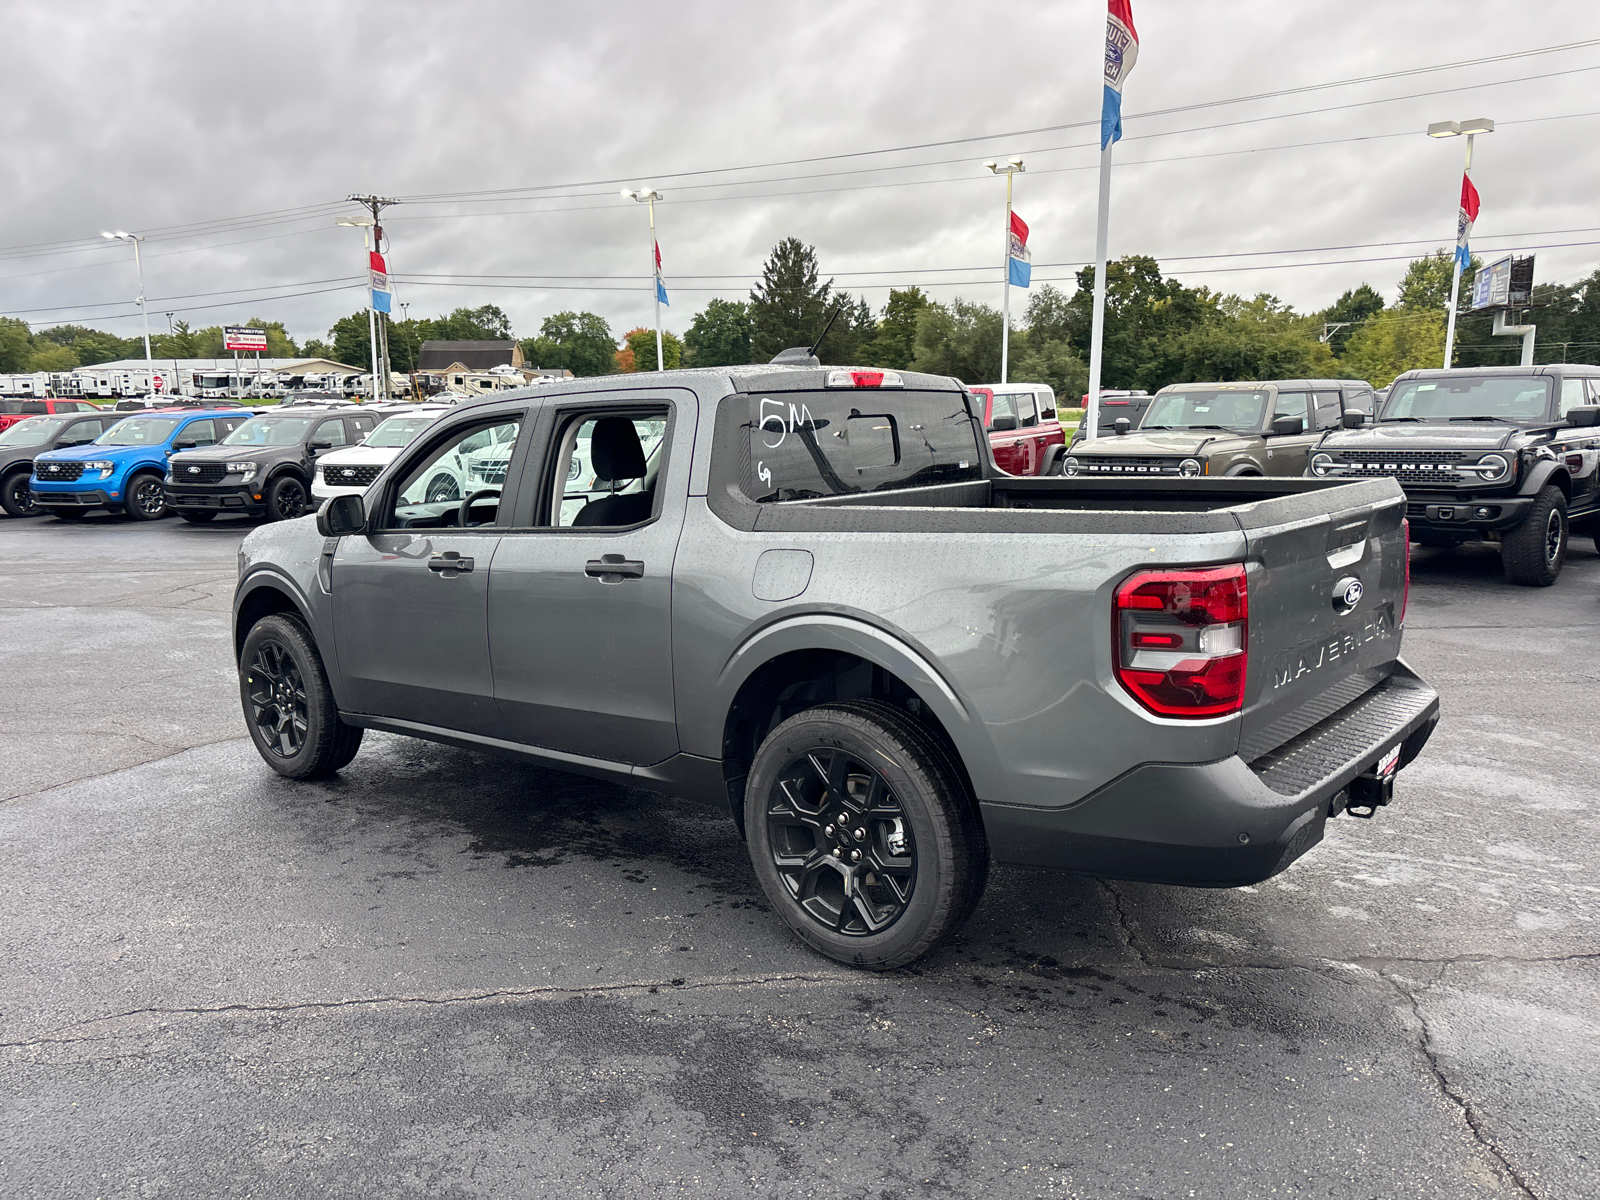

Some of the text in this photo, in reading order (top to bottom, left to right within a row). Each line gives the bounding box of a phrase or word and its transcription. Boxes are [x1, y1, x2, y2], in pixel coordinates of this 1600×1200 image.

[1089, 465, 1161, 473] BRONCO
[1350, 463, 1454, 471] BRONCO
[1272, 614, 1386, 690] MAVERICK
